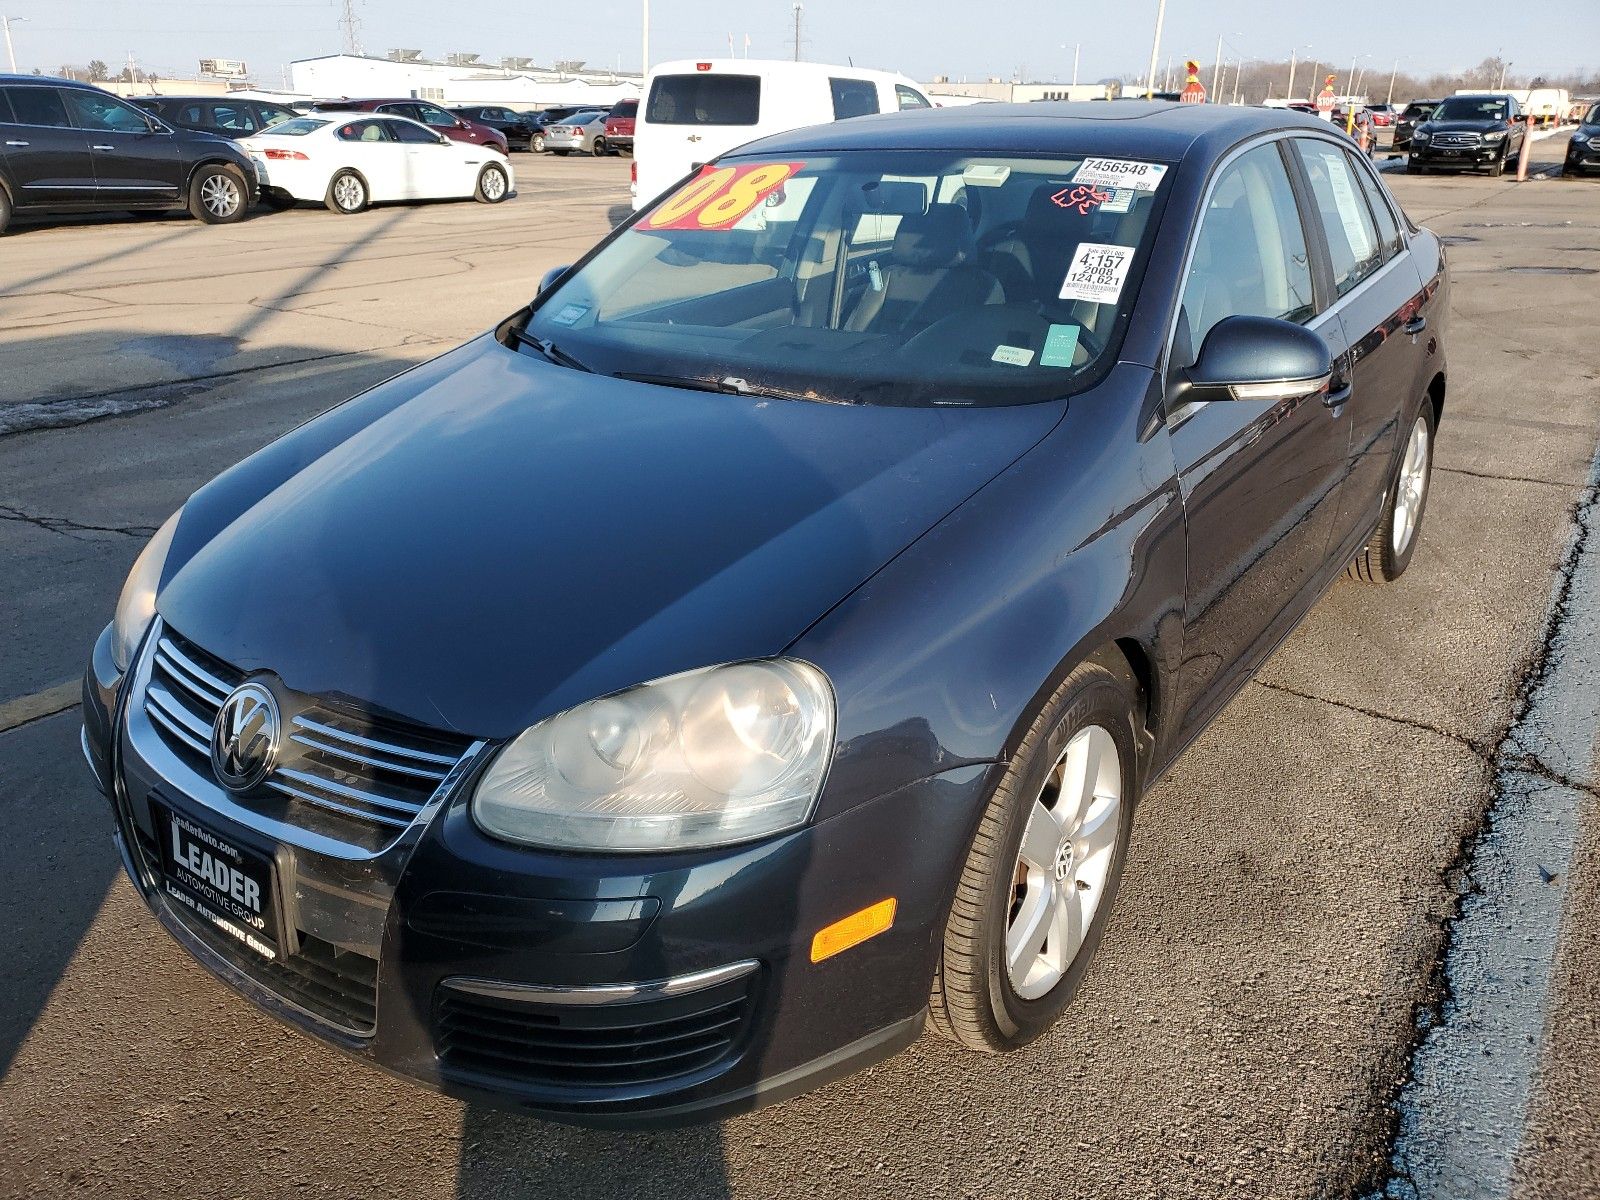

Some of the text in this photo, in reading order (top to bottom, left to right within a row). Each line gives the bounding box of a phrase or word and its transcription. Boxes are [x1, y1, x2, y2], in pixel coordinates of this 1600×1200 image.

[1182, 92, 1204, 104] STOP
[1316, 97, 1335, 106] STOP
[1084, 160, 1149, 176] 7456548
[649, 166, 791, 228] 08
[1080, 252, 1125, 269] 4:157
[1083, 265, 1114, 276] 2008
[171, 811, 239, 858] LeaderAuto.com
[171, 821, 261, 913] LEADER
[176, 867, 265, 930] AUTOMOTIVE GROUP
[166, 880, 276, 960] LEADER AUTOMOTIVE GROUP
